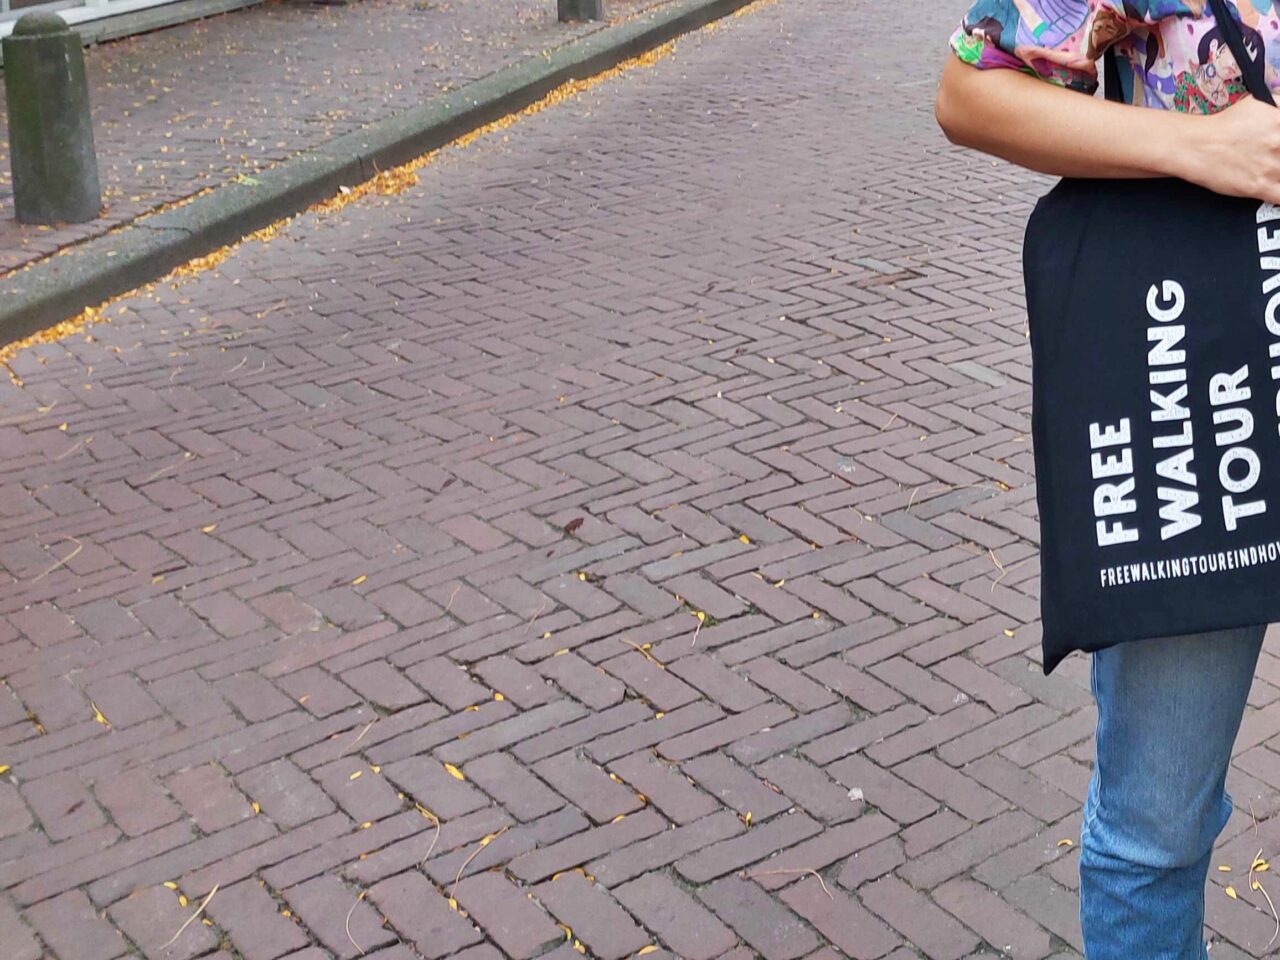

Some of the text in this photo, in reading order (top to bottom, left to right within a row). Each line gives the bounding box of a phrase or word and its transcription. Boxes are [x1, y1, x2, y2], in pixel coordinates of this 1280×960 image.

[1089, 417, 1139, 547] FREE
[1146, 279, 1203, 541] WALKING
[1209, 364, 1267, 531] TOUR
